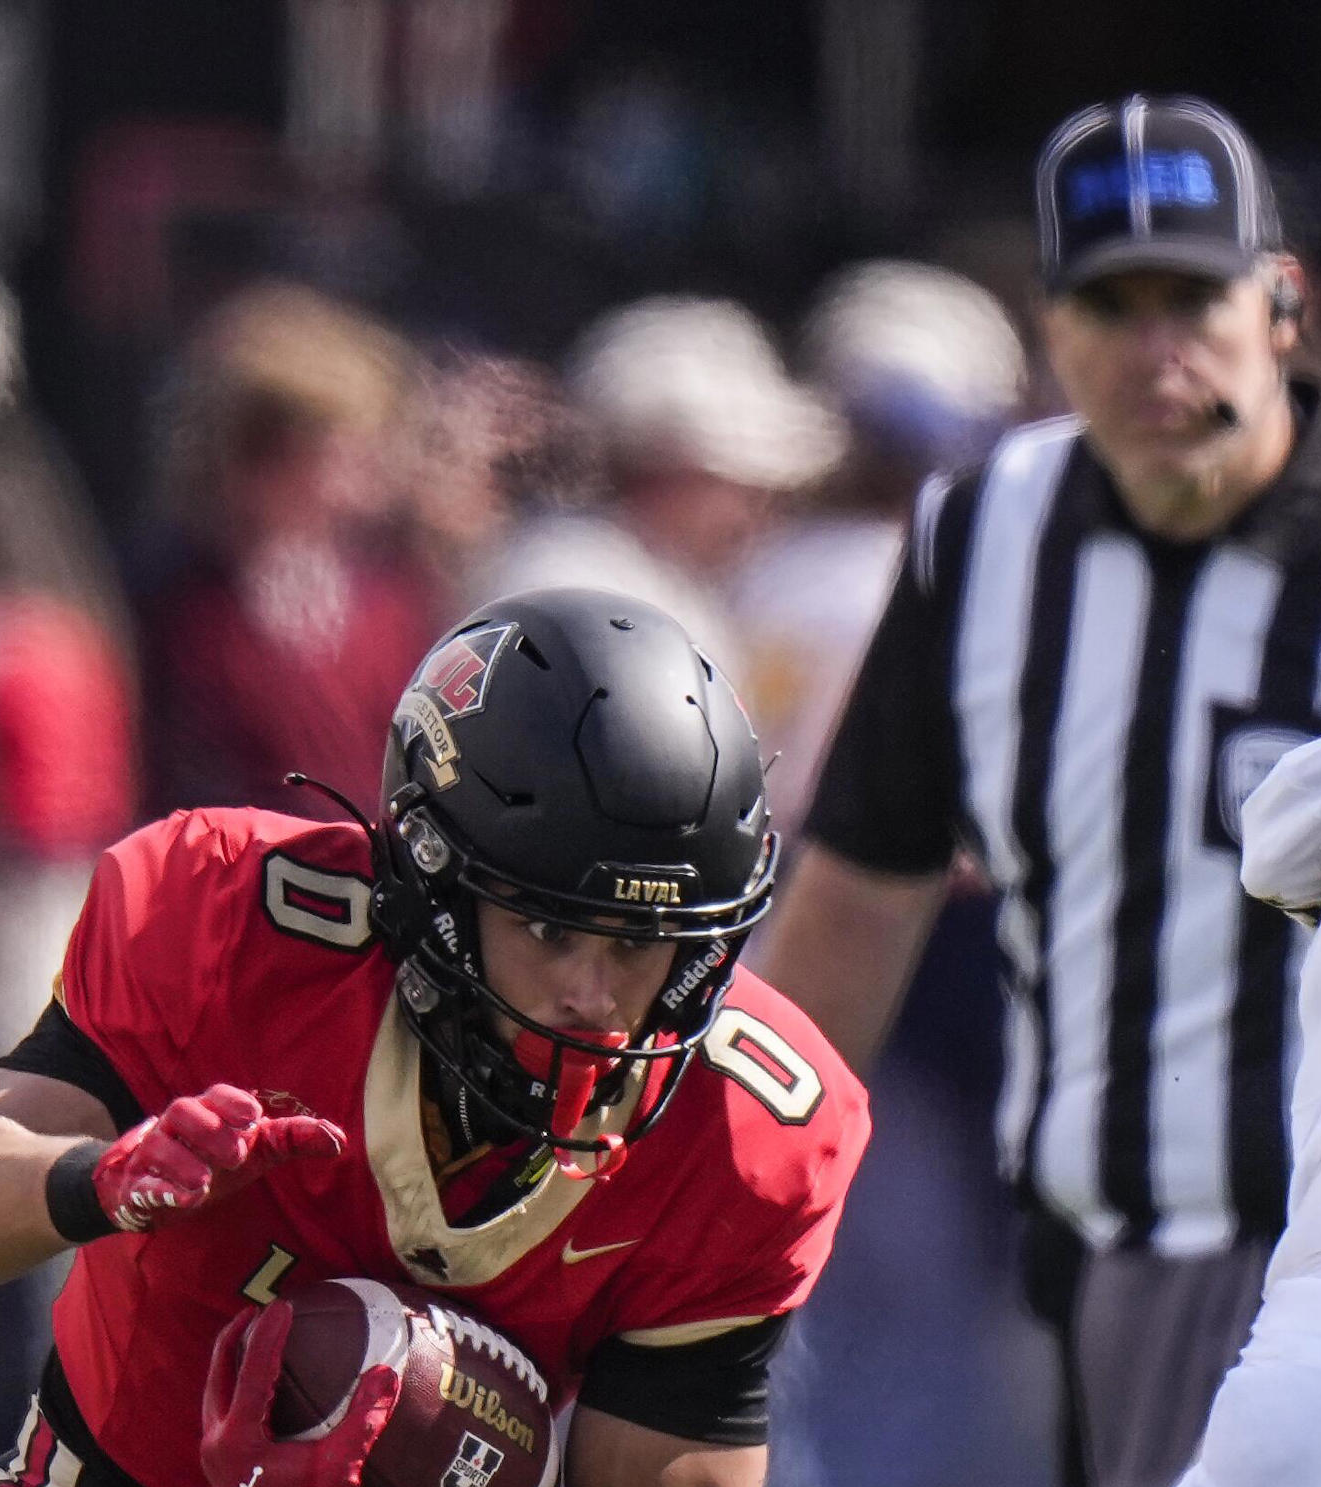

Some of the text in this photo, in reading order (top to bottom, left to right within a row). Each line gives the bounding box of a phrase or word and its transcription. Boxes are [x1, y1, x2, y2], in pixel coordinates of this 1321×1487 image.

[263, 846, 378, 956] 0
[614, 878, 681, 904] LAVAL
[661, 938, 731, 1011] Riddell
[699, 1004, 827, 1128] 0
[439, 1361, 535, 1454] Wilson
